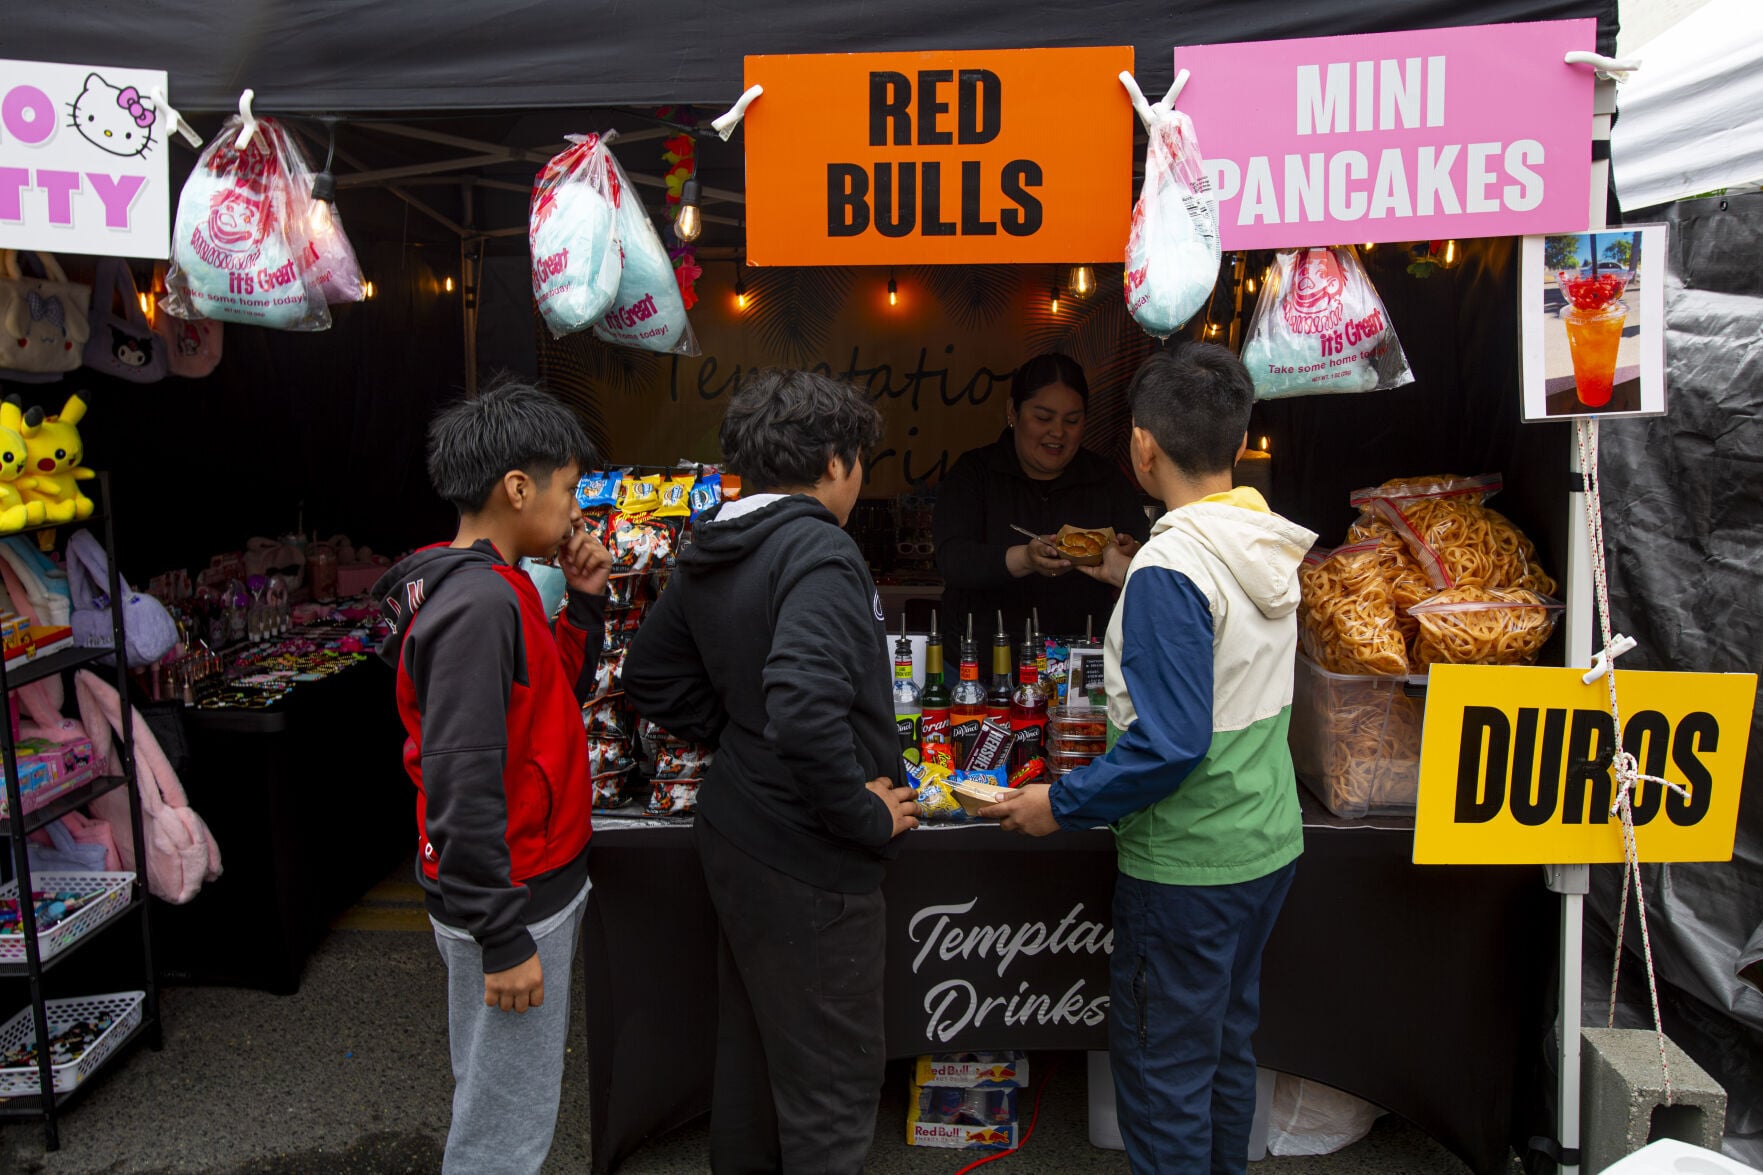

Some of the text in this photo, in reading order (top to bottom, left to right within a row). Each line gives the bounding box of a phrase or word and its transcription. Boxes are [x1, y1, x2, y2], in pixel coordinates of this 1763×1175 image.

[0, 85, 56, 145] O
[868, 68, 1002, 147] RED
[1296, 55, 1446, 136] MINI
[827, 158, 1043, 238] BULLS
[1200, 139, 1546, 226] PANCAKES
[257, 258, 297, 293] Great
[536, 247, 569, 284] Great
[207, 293, 235, 305] some
[239, 296, 270, 307] home
[273, 292, 306, 306] today!
[619, 292, 659, 328] Great
[639, 323, 669, 339] today!
[1320, 307, 1385, 357] it's Great
[1268, 364, 1294, 374] Take
[1297, 362, 1326, 374] some
[1329, 354, 1357, 368] home
[921, 716, 950, 733] Toran
[1453, 705, 1720, 828] DUROS
[908, 896, 1115, 978] Tempta
[923, 978, 1111, 1043] Drinks
[947, 1065, 969, 1076] Bull
[915, 1125, 960, 1138] Red Bull
